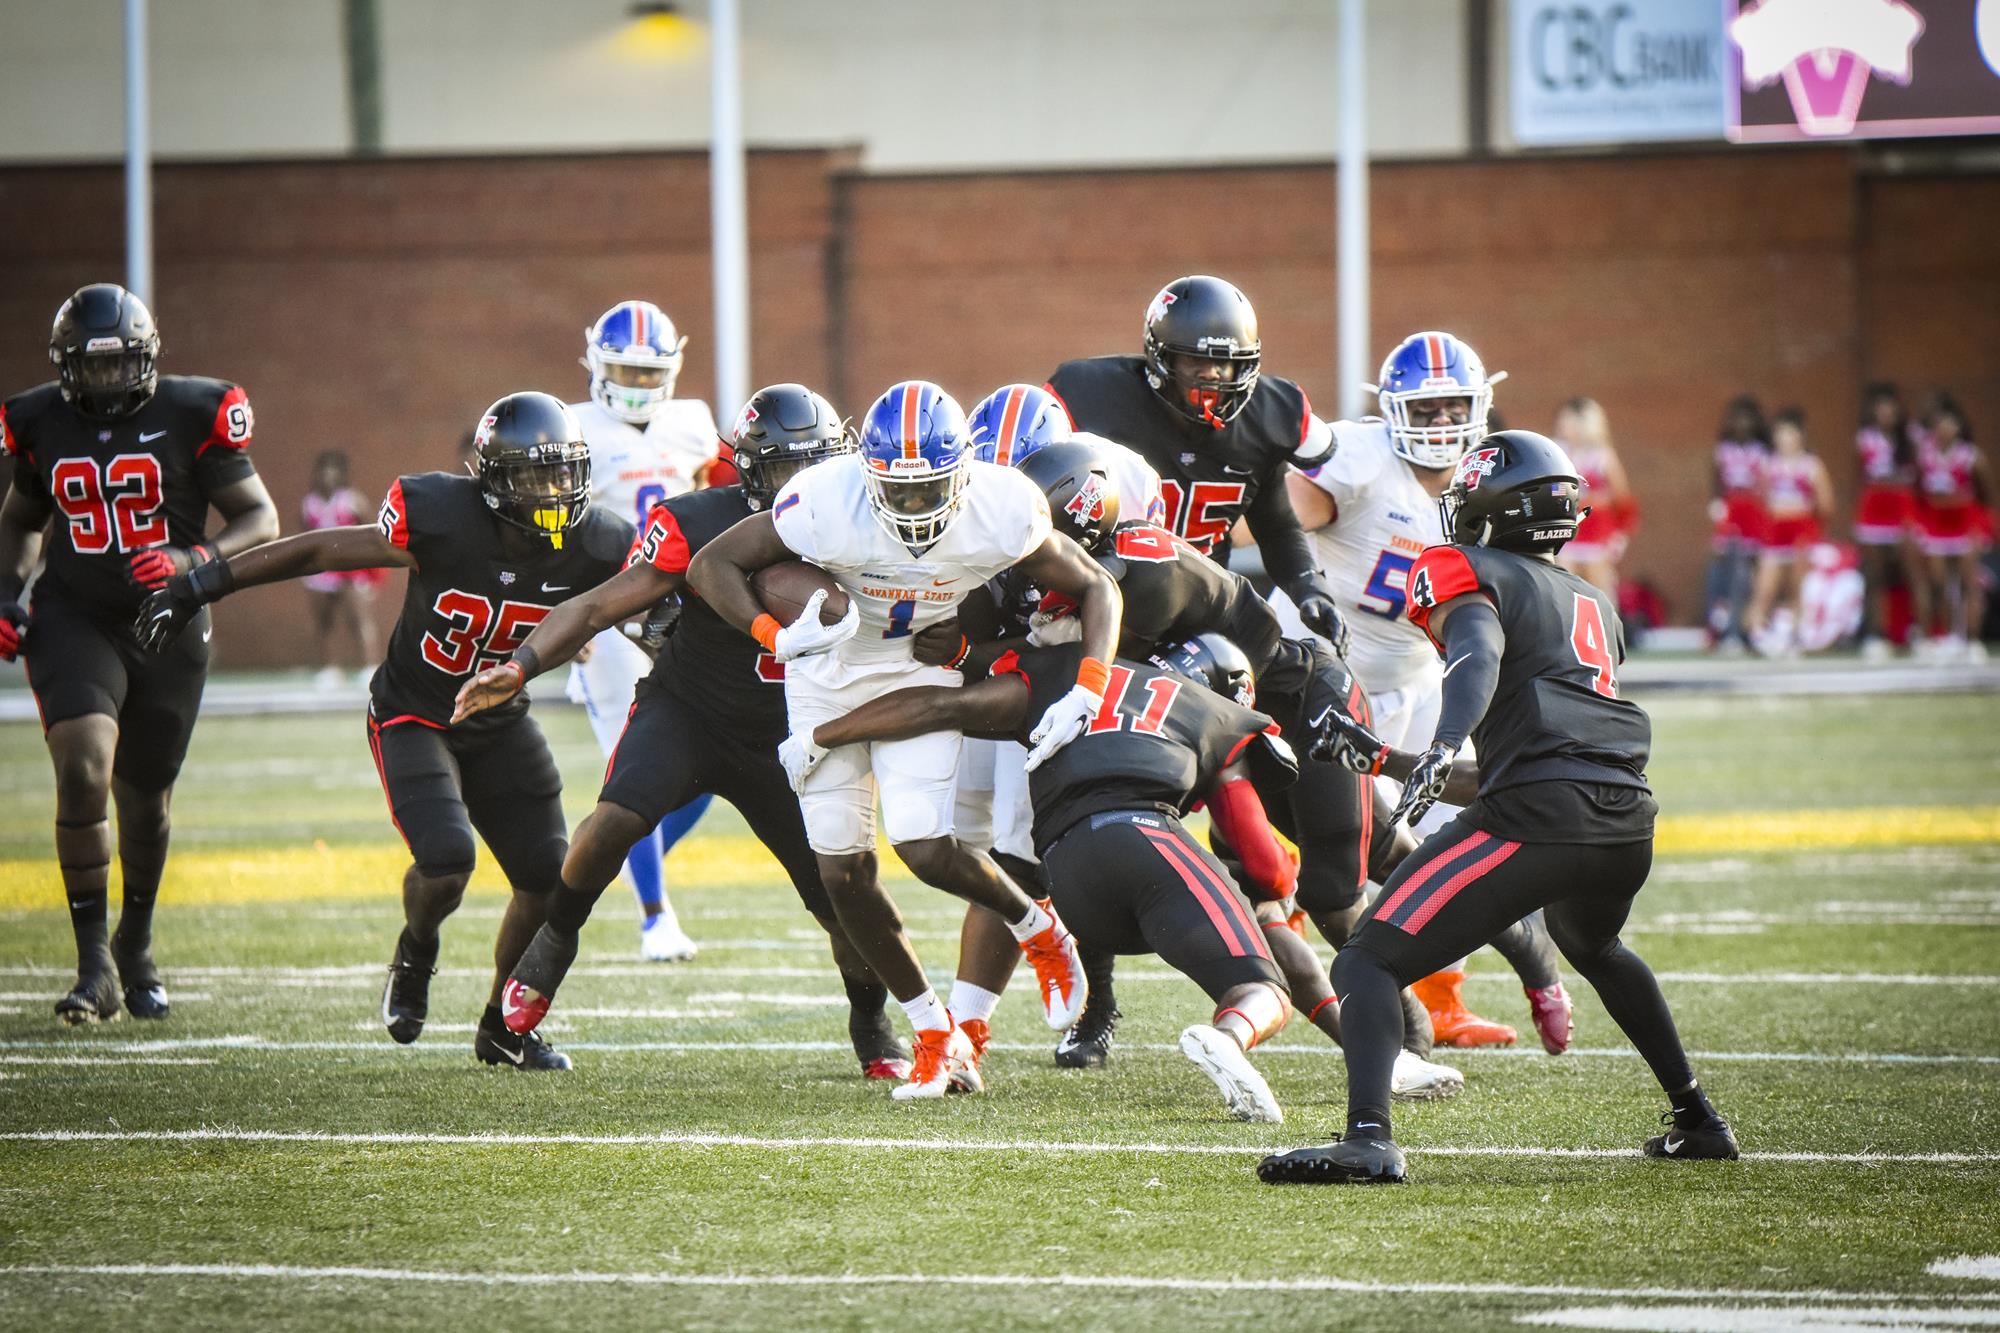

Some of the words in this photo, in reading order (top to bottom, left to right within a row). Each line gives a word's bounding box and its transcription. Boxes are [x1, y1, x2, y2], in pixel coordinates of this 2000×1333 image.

[226, 402, 254, 443] 9
[539, 443, 561, 454] VSU
[788, 440, 818, 451] Riddell
[894, 461, 925, 469] Riddell
[52, 453, 170, 554] 92
[377, 498, 401, 543] 5
[1533, 529, 1573, 541] BLAZERS
[862, 586, 917, 600] SAVANNAH
[923, 591, 954, 600] STATE
[1412, 566, 1437, 608] 4
[420, 588, 557, 676] 35
[881, 599, 917, 640] 1
[1148, 654, 1174, 672] BLAZ
[1181, 655, 1195, 668] 11
[1570, 592, 1617, 699] 4
[1084, 664, 1183, 740] 11
